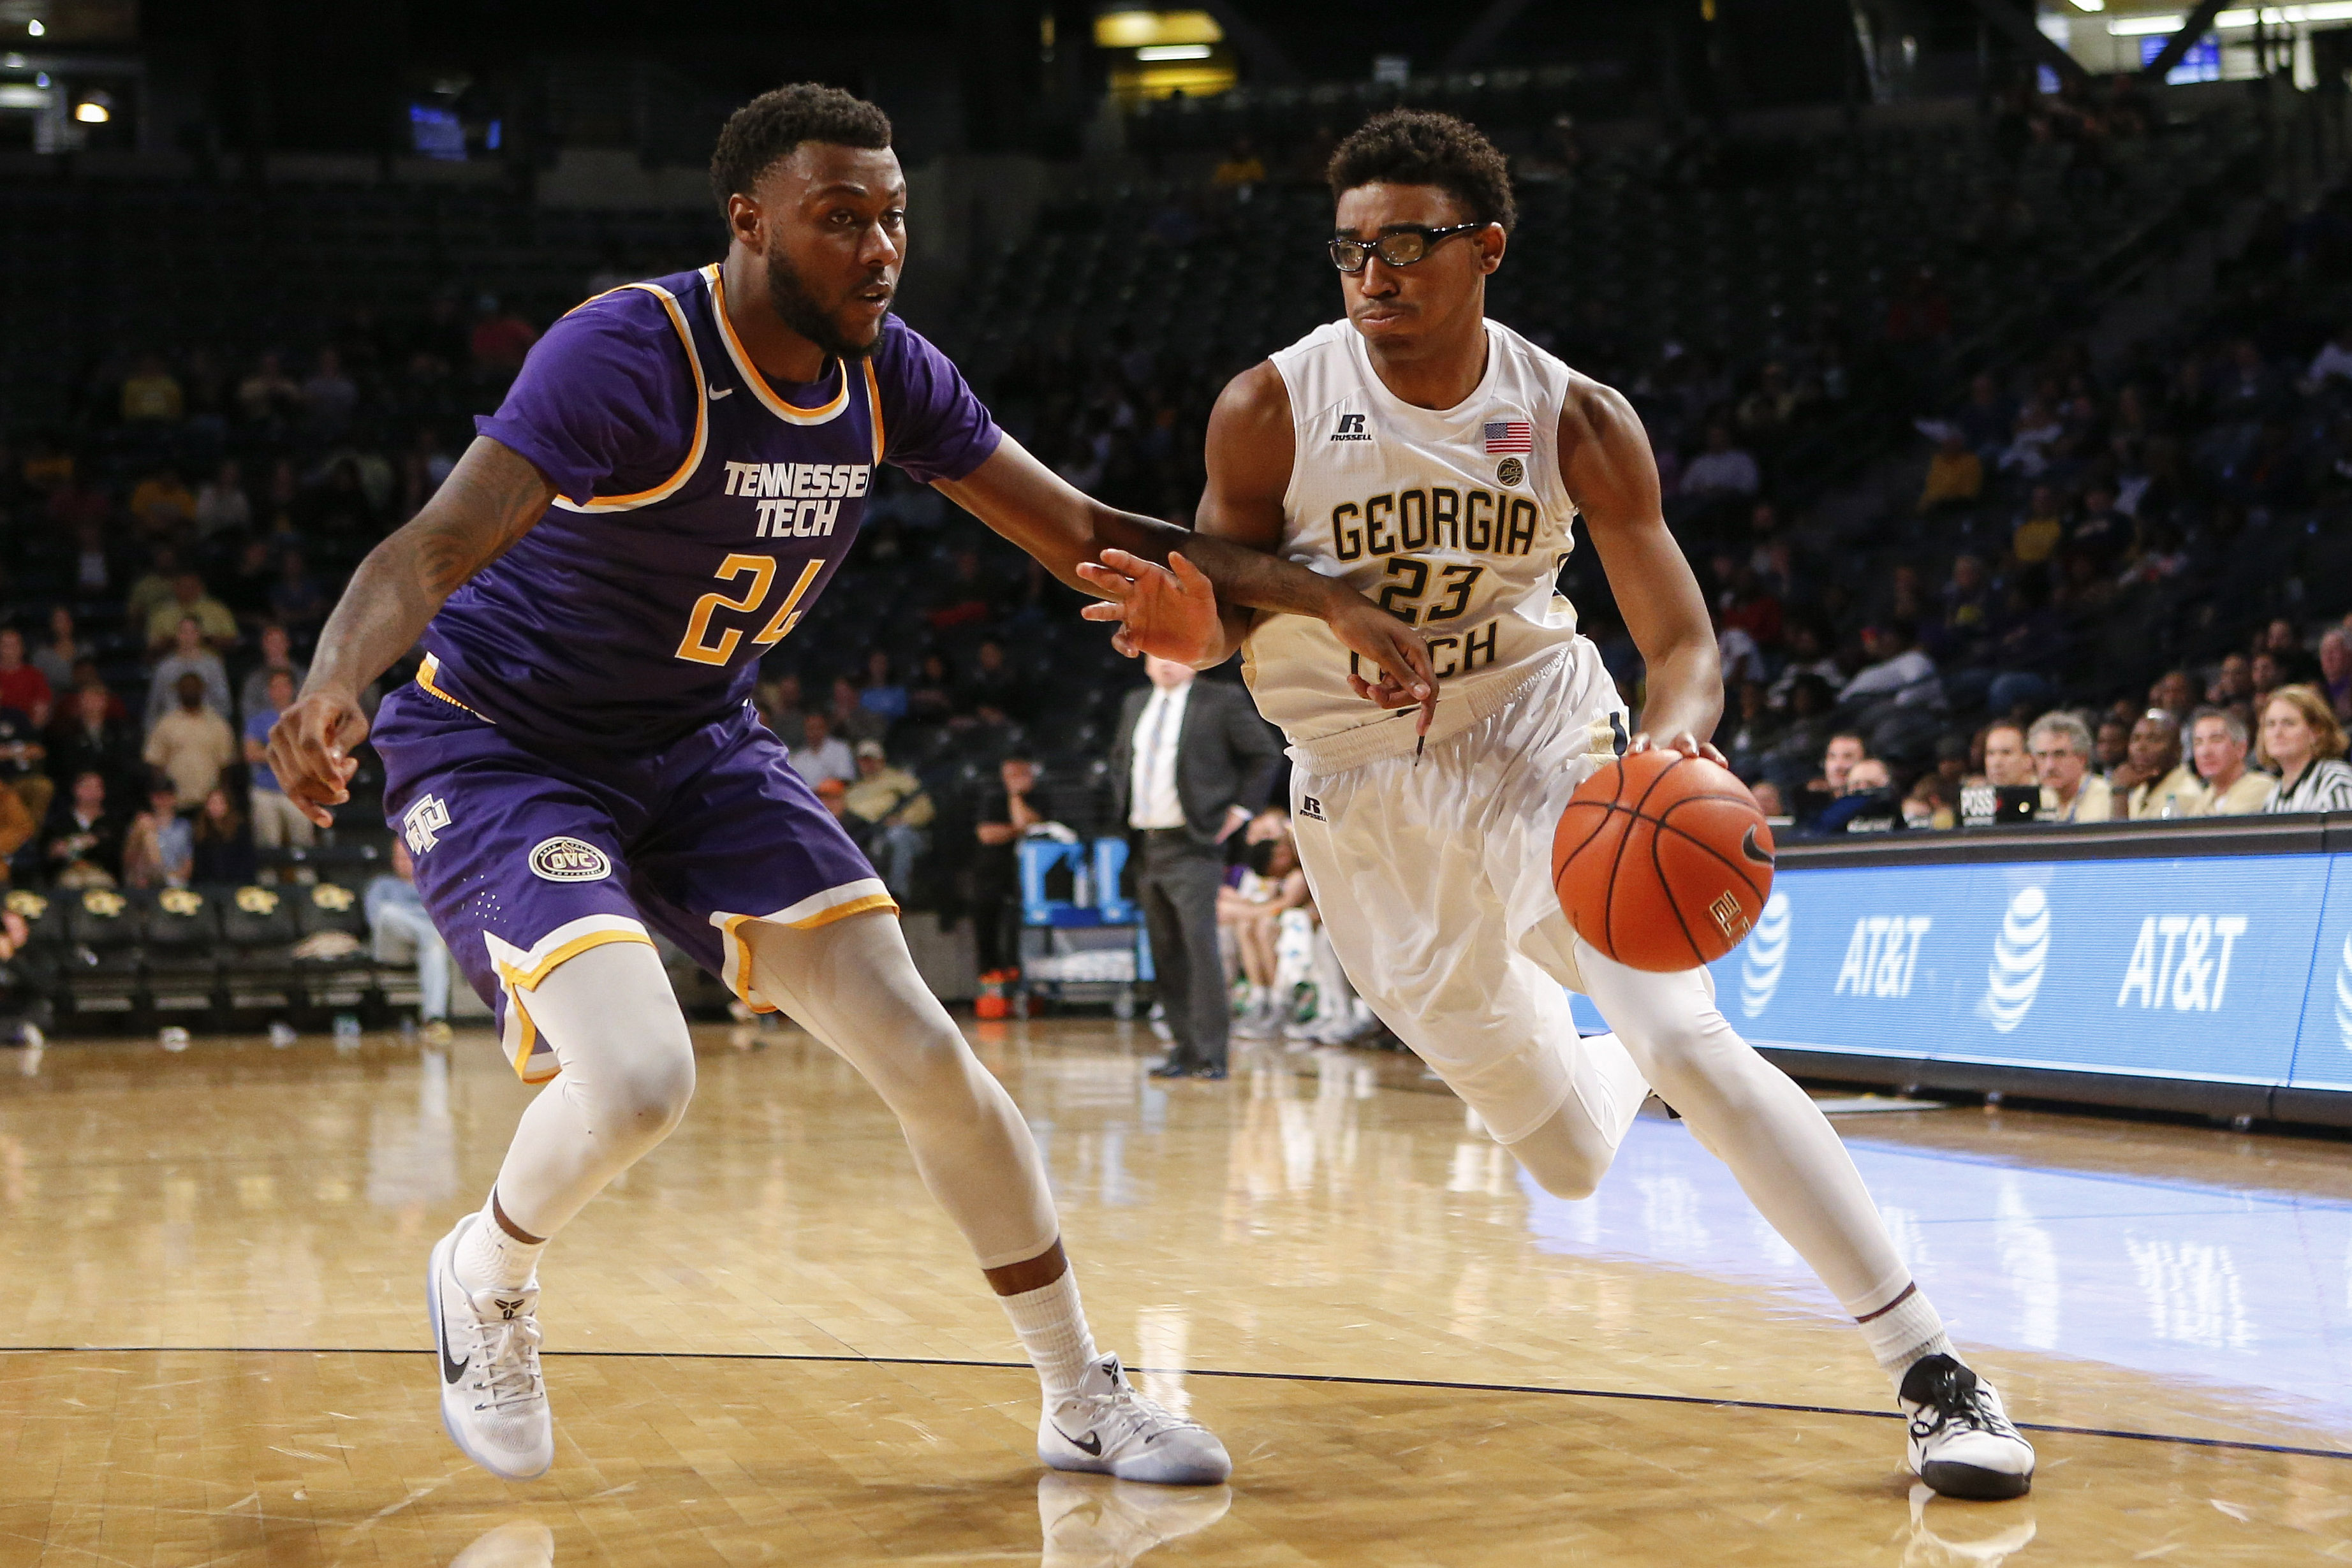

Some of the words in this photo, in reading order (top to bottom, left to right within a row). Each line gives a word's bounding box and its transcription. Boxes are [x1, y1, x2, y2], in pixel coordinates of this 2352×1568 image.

[724, 460, 871, 498] TENNESSE
[755, 499, 841, 538] TECH
[1332, 487, 1538, 562] GEORGIA
[675, 553, 826, 666] 24
[1378, 557, 1485, 625] 23
[550, 852, 593, 868] OVC
[1835, 916, 1932, 997] AT&T
[2117, 914, 2247, 1011] AT&T
